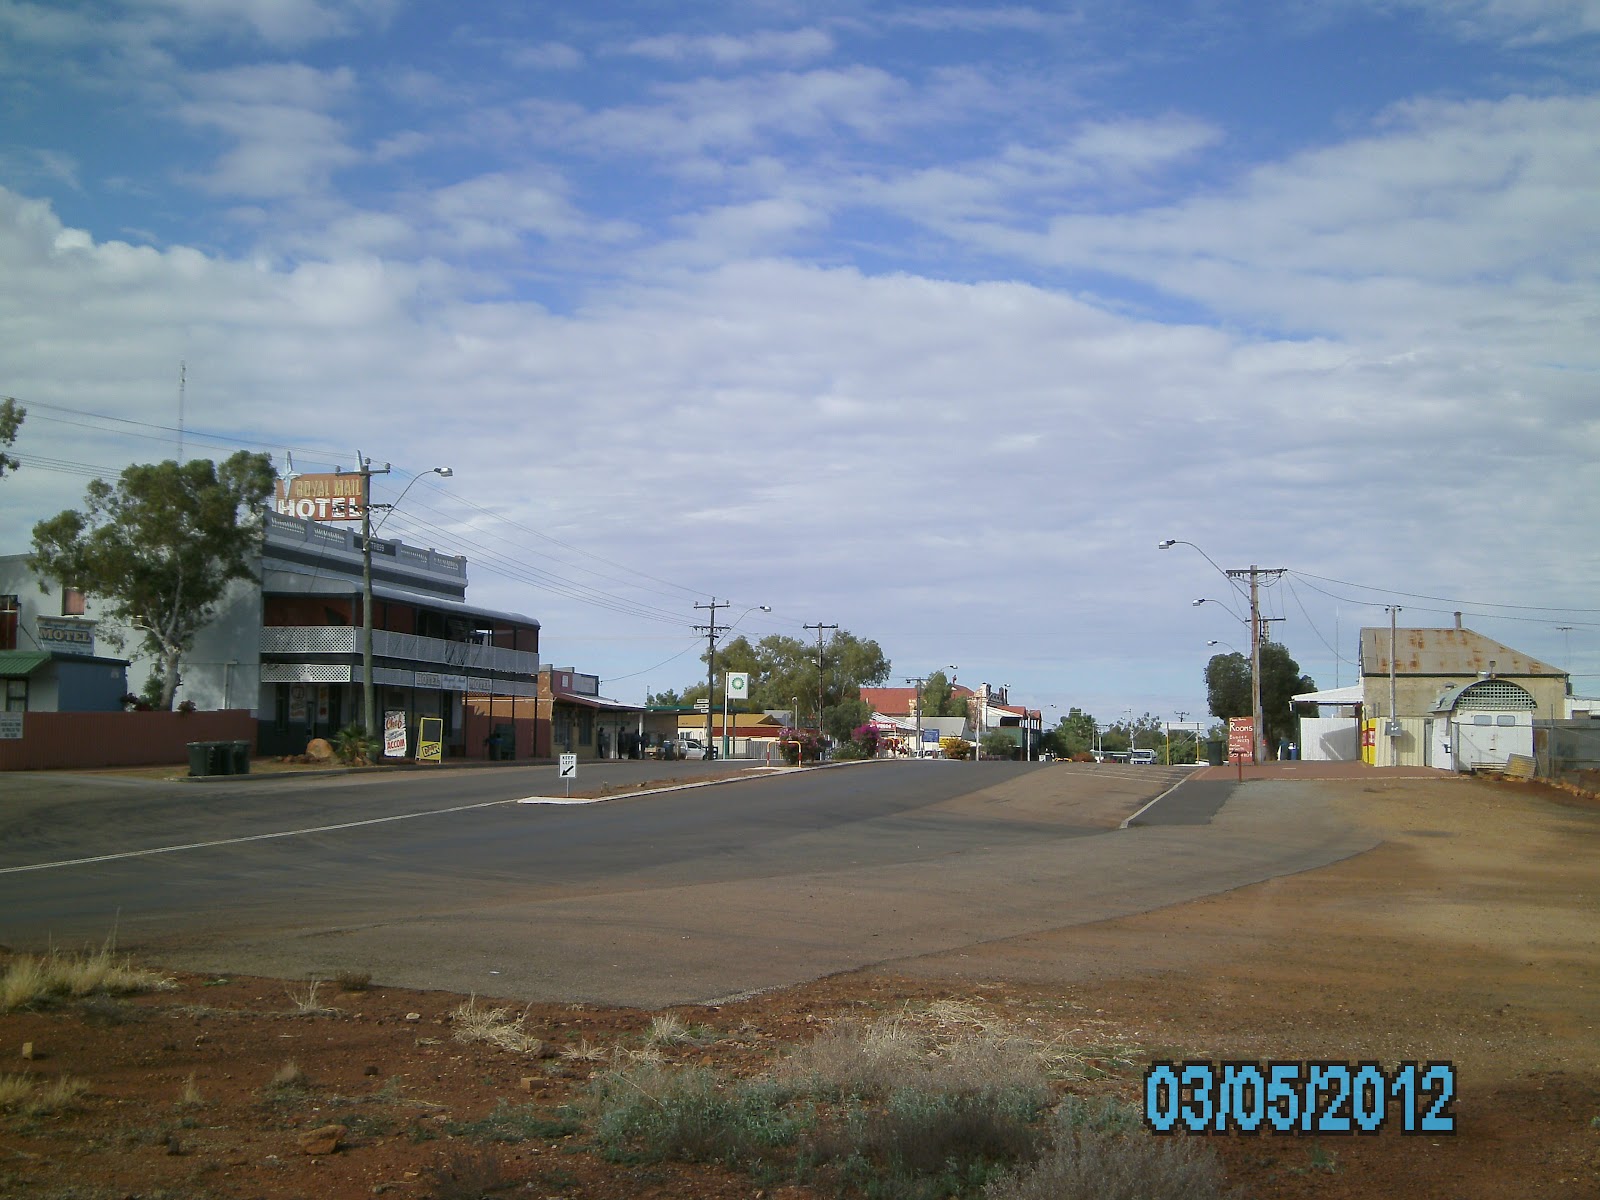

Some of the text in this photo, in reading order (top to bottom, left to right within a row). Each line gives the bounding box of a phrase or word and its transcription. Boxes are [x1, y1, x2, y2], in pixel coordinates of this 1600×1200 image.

[296, 479, 361, 497] ROYAL MAIL
[277, 498, 363, 518] HOTEL
[39, 627, 92, 643] MOTEL
